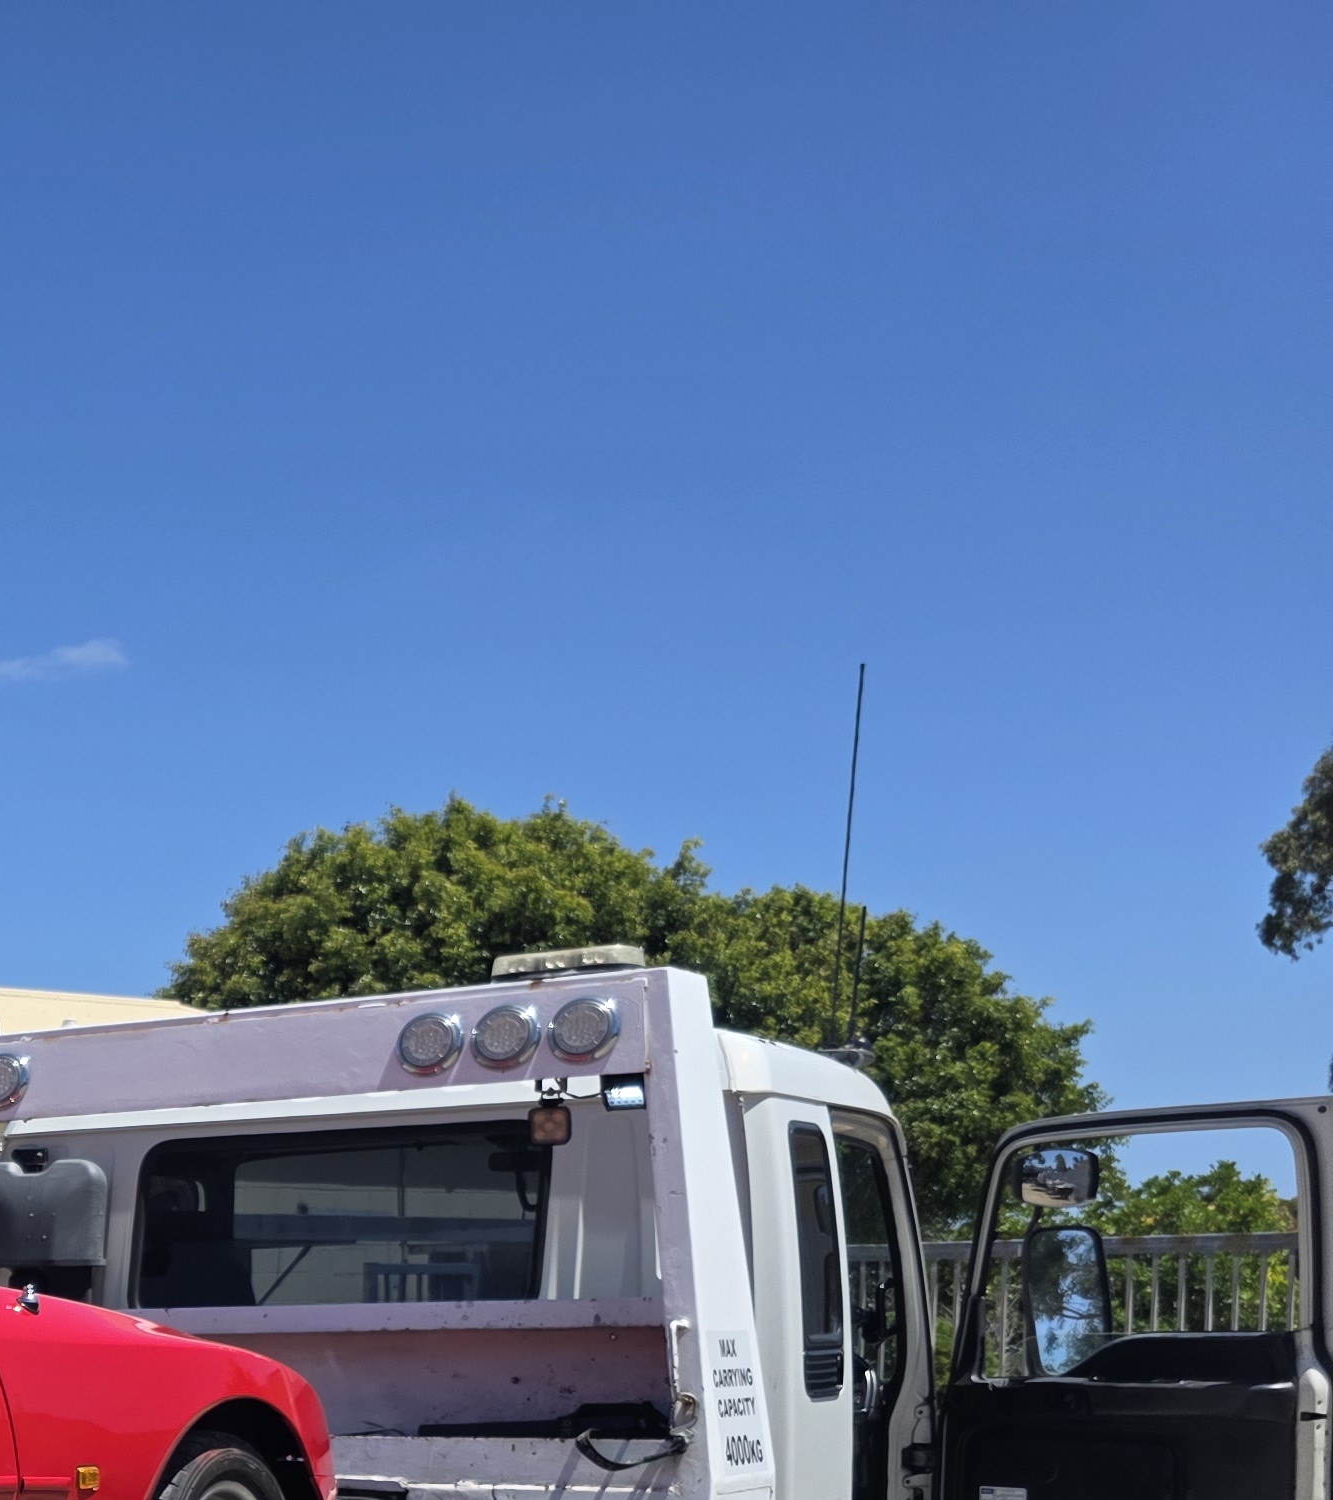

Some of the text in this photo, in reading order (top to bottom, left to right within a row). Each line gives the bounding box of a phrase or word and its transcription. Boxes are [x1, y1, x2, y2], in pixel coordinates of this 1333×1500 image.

[718, 1339, 738, 1358] MAX
[712, 1367, 753, 1389] CARRYING
[717, 1397, 756, 1418] CAPACITY
[725, 1434, 764, 1467] 4000KG
